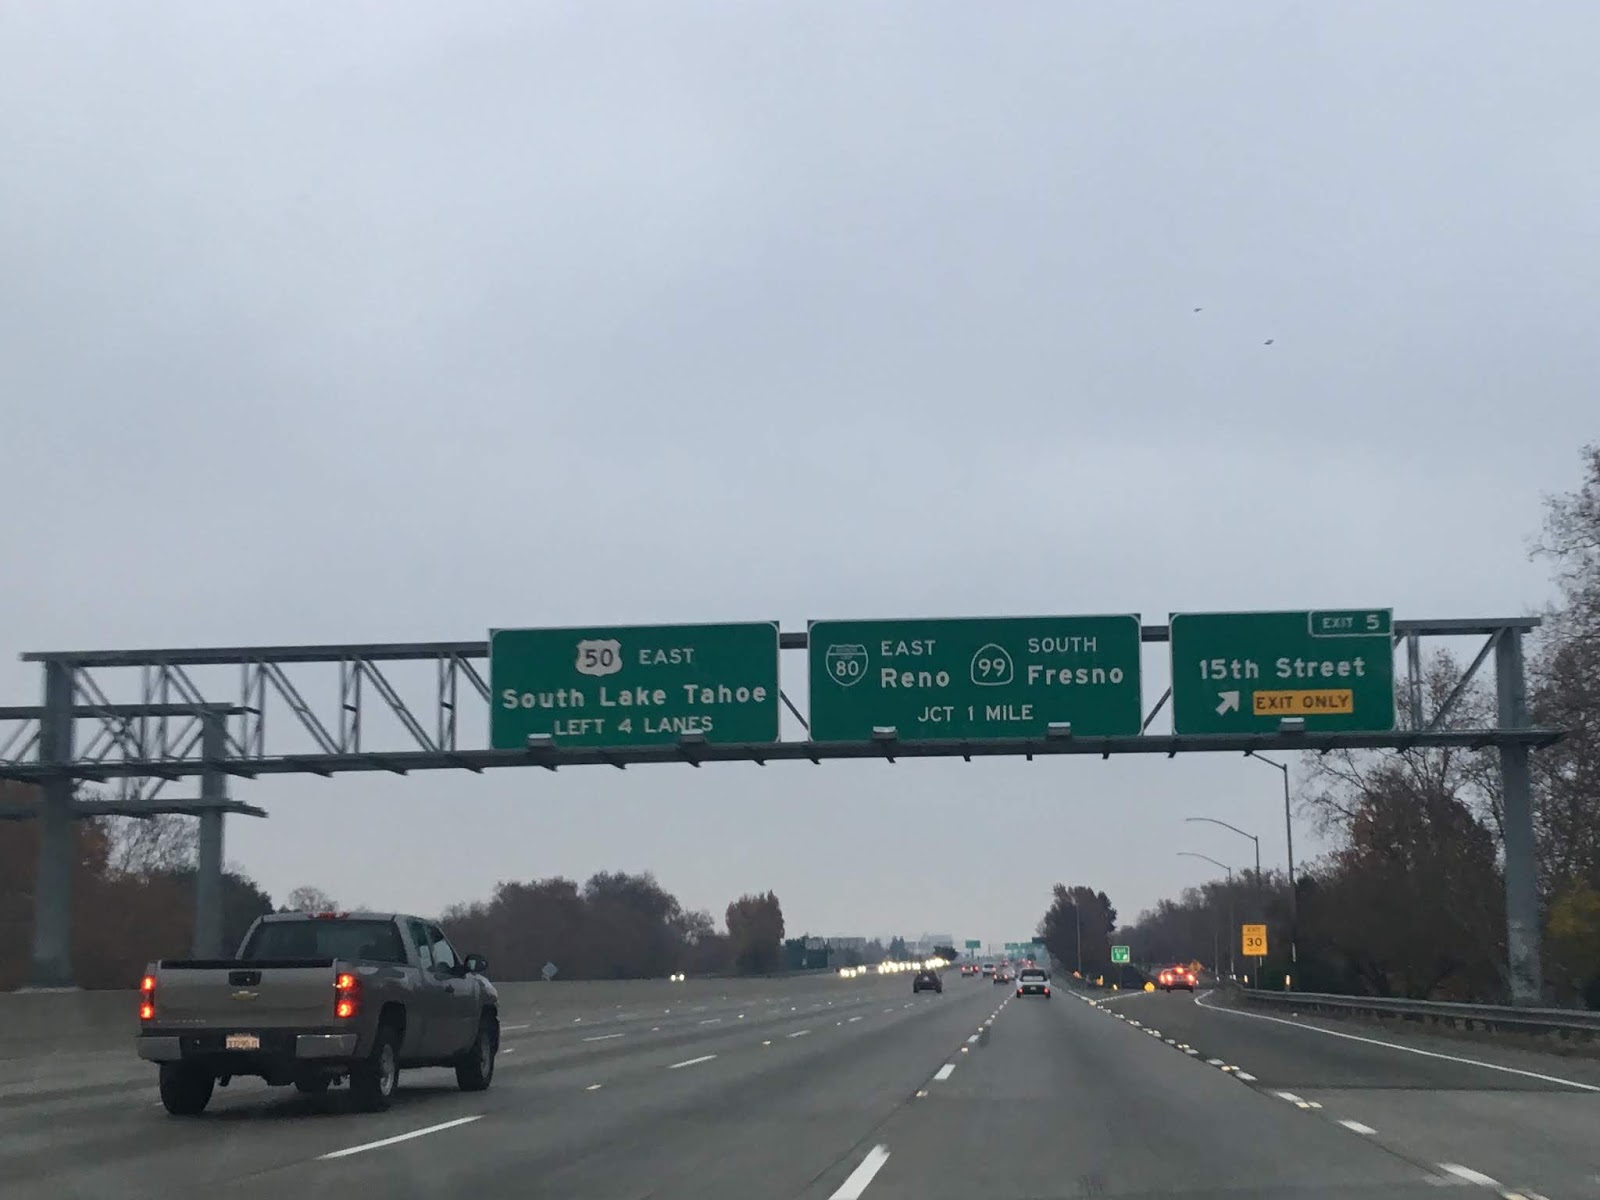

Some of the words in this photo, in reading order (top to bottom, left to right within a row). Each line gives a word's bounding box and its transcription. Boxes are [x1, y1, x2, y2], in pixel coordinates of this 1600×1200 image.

[1323, 617, 1353, 629] EXIT
[1366, 614, 1379, 630] 5
[881, 640, 936, 656] EAST
[1028, 637, 1097, 654] SOUTH
[585, 648, 614, 668] 50
[639, 648, 695, 665] EAST
[836, 660, 859, 676] 80
[978, 658, 1006, 678] 99
[1028, 664, 1124, 686] Fresno
[1200, 658, 1259, 680] 15th
[1275, 657, 1366, 679] Street
[881, 667, 950, 688] Reno
[502, 688, 585, 710] South
[600, 686, 667, 707] Lake
[683, 684, 767, 705] Tahoe
[1256, 696, 1293, 710] EXIT
[1303, 695, 1349, 708] ONLY
[917, 706, 954, 722] JCT
[968, 705, 975, 721] 1
[986, 704, 1034, 721] MILE
[555, 718, 605, 736] LEFT
[618, 718, 632, 734] 4
[644, 716, 714, 733] LANES
[1247, 937, 1262, 947] 30
